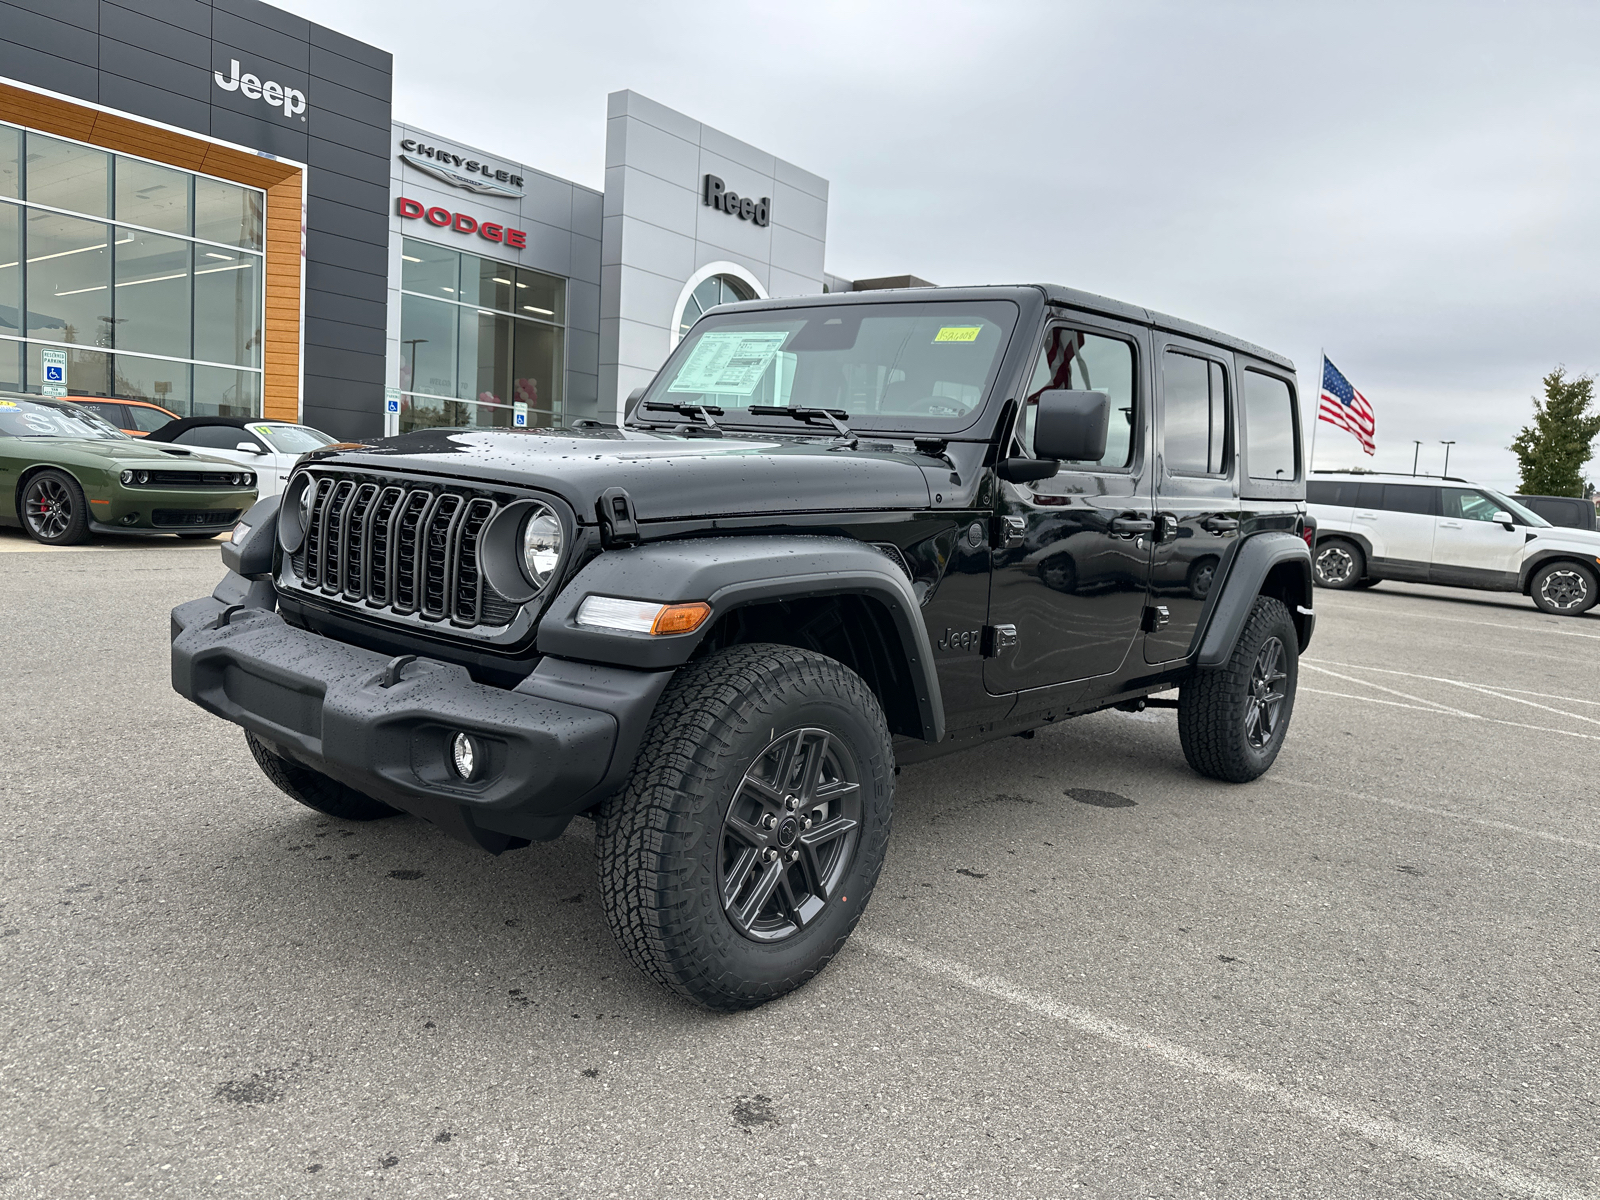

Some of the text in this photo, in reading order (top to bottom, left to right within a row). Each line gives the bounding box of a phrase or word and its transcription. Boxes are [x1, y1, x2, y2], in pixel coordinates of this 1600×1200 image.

[214, 58, 306, 118] Jeep
[400, 139, 525, 188] CHRYSLER
[397, 197, 527, 249] DODGE
[704, 173, 771, 228] Reed
[44, 357, 65, 365] PARKING
[937, 627, 979, 652] Jeep
